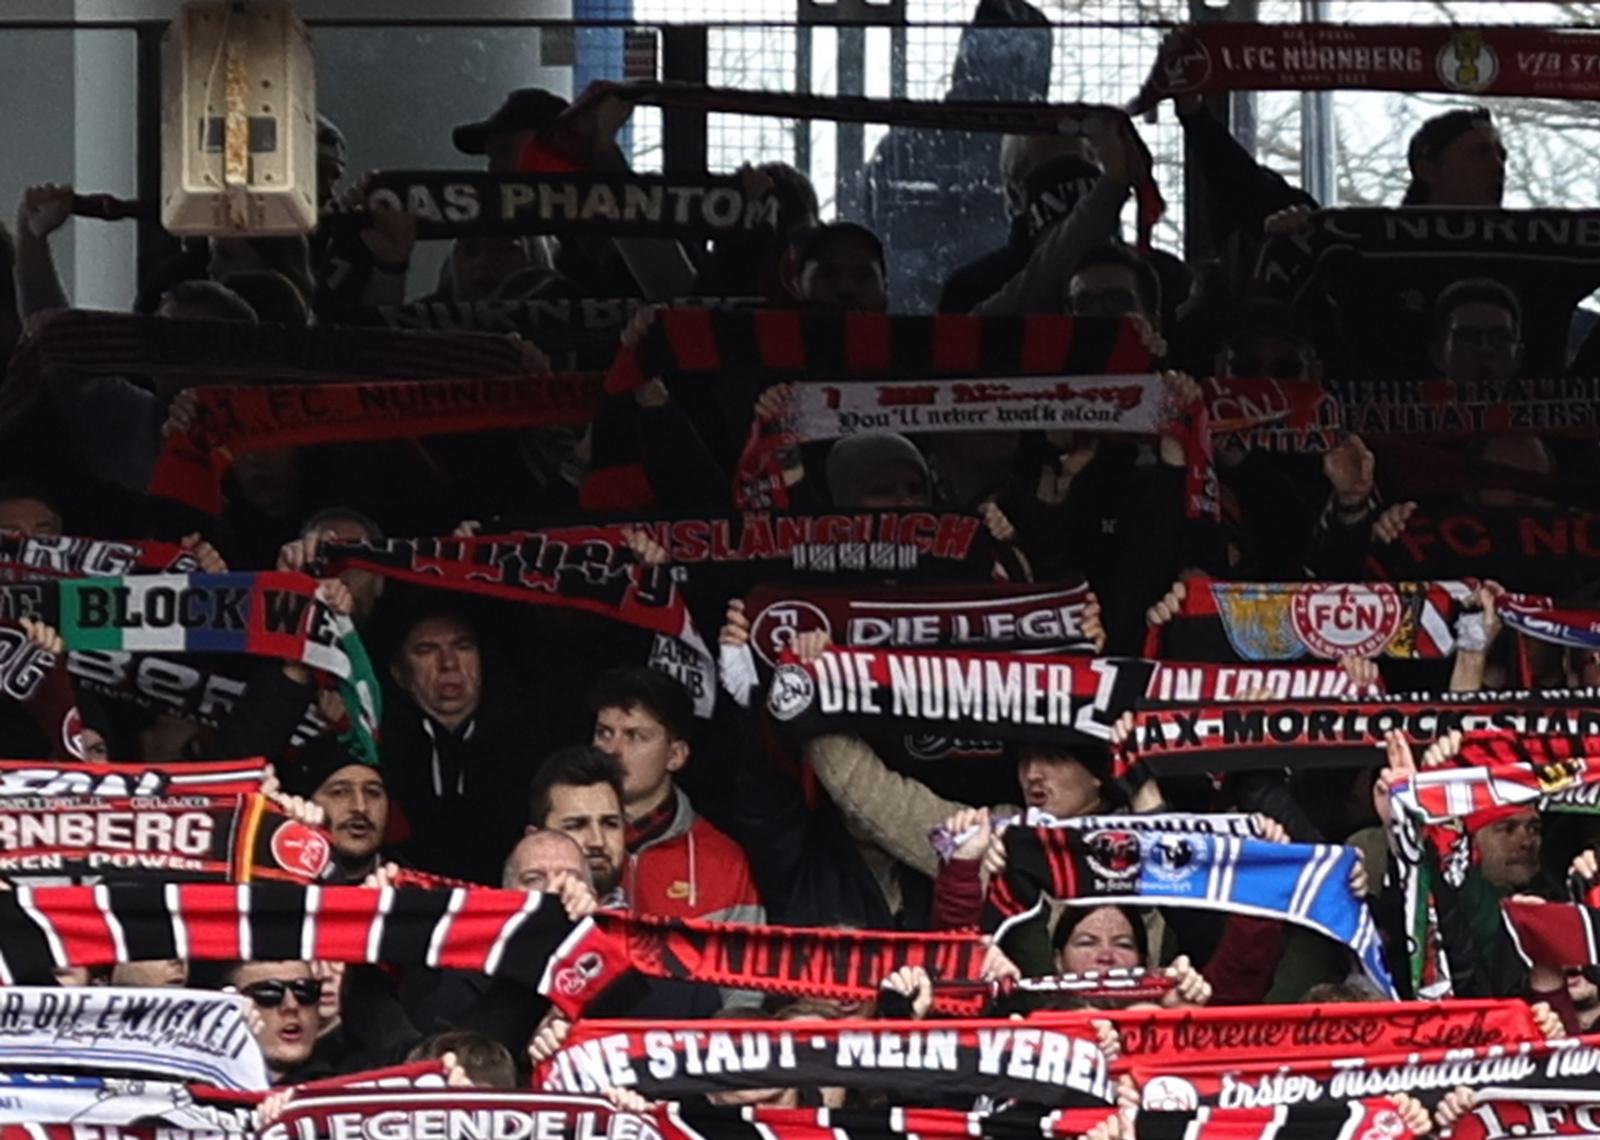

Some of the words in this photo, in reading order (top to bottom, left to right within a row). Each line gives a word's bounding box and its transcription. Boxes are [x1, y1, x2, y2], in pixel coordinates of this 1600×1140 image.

[78, 585, 251, 629] BLOCK
[1315, 604, 1380, 632] FCN
[818, 652, 882, 715] DIE
[885, 653, 1075, 726] NUMMER
[648, 1030, 797, 1080] STADT
[836, 1030, 960, 1068] MEIN
